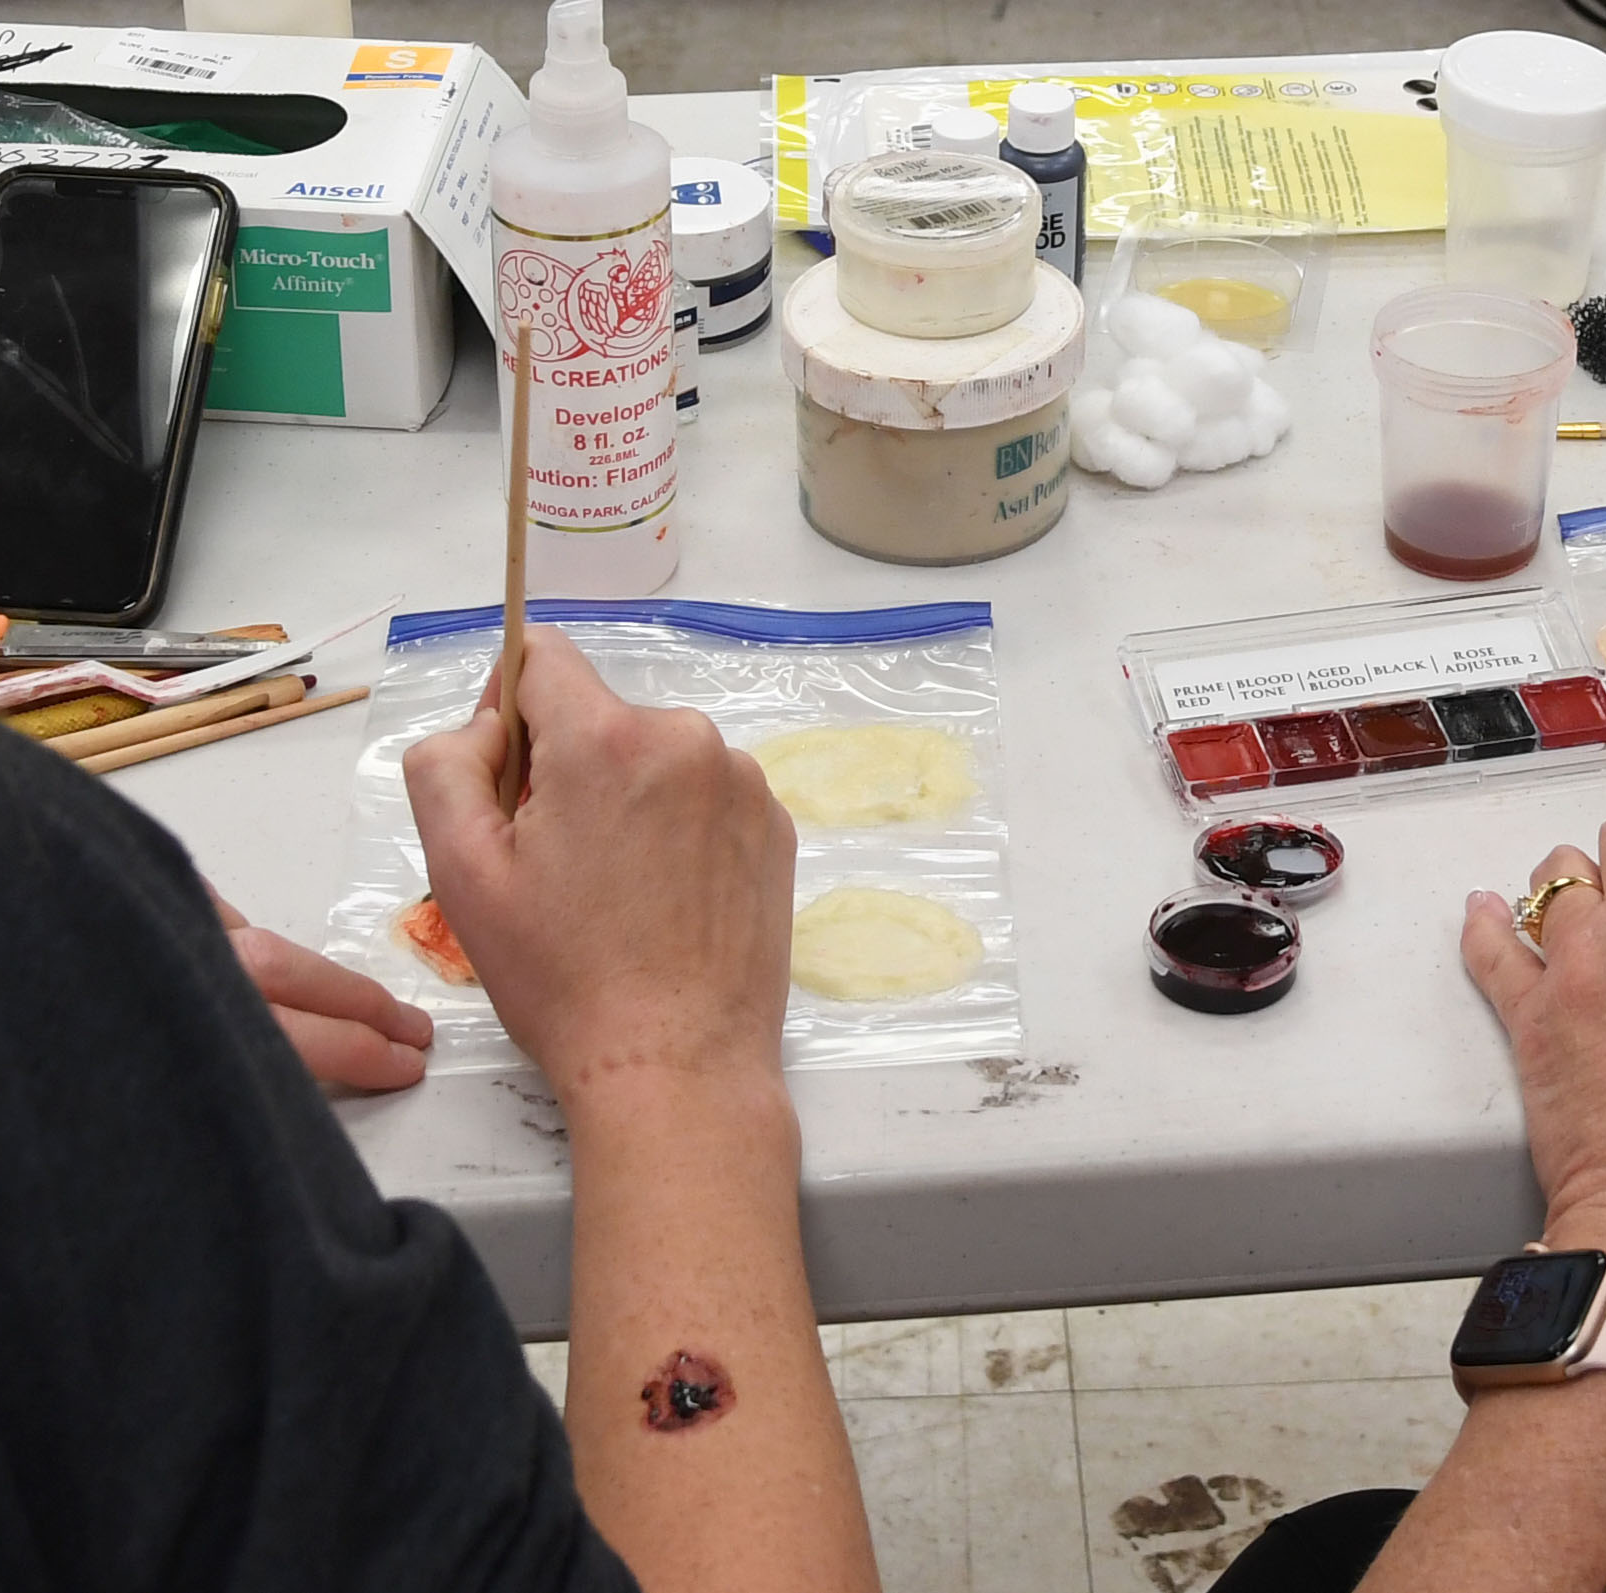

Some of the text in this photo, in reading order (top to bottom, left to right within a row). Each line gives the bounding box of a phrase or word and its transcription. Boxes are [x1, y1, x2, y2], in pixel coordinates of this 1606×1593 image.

[385, 49, 418, 69] S
[285, 182, 385, 198] Ansell
[240, 248, 376, 270] Micro-Touch
[272, 275, 345, 297] Affinity
[503, 350, 545, 384] REL
[556, 391, 662, 426] Developer
[574, 426, 650, 451] 8 fl. oz.
[589, 448, 640, 466] 226.8ML
[998, 441, 1032, 477] BN
[527, 465, 598, 489] aution:
[527, 500, 579, 519] ANOGA
[583, 504, 628, 519] PARK,
[1453, 646, 1496, 661] ROSE
[1306, 664, 1351, 680] AGED
[1373, 659, 1427, 676] BLACK
[1444, 653, 1539, 674] ADJUSTER 2
[1173, 681, 1225, 698] PRIME
[1236, 672, 1295, 690] BLOOD
[1309, 674, 1367, 692] BLOOD
[1177, 695, 1211, 709] RED
[1239, 685, 1287, 701] TONE
